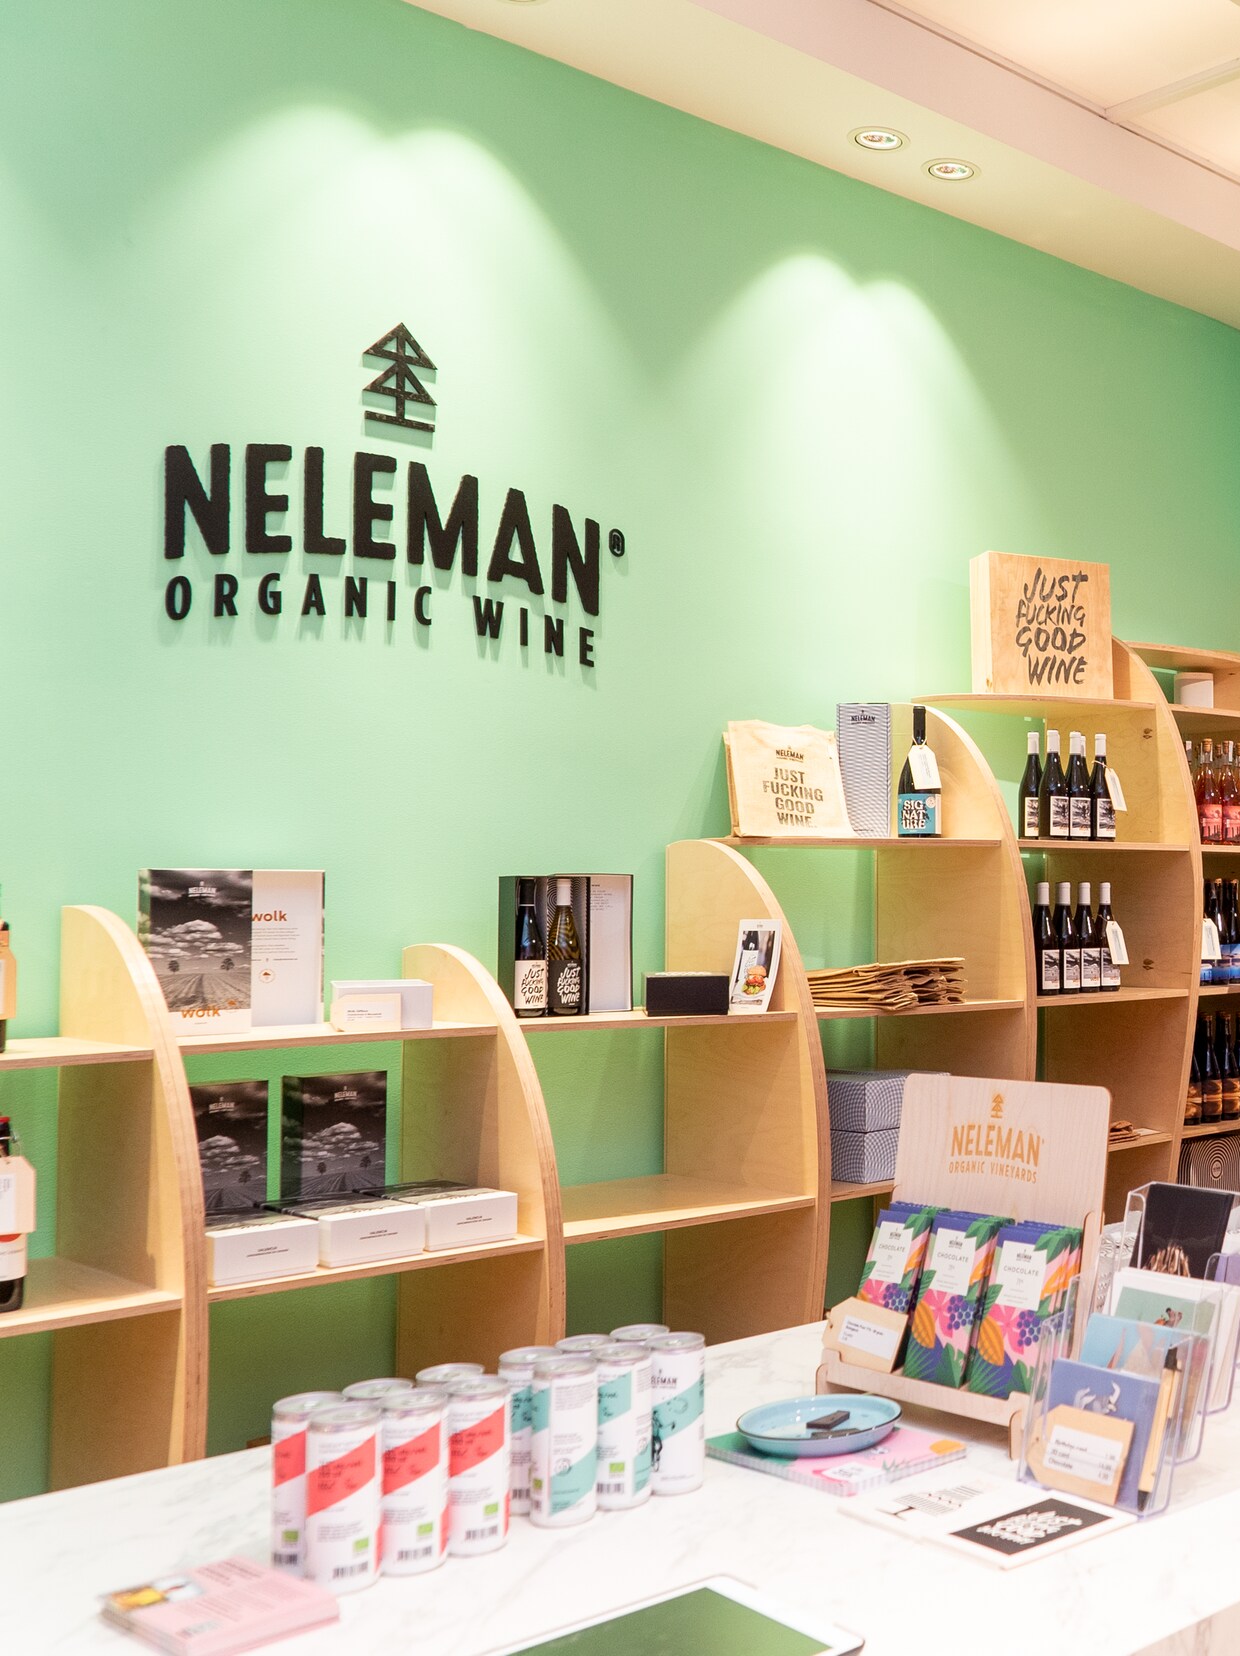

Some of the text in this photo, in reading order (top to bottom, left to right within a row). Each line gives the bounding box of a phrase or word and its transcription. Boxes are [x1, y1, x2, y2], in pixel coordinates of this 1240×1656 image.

[1023, 567, 1089, 604] JUST
[165, 572, 596, 668] ORGANIC WINE
[1016, 599, 1086, 628] FUCKING
[1016, 626, 1087, 658] GOOD
[1028, 654, 1088, 686] WINE
[775, 749, 804, 761] NELEMAN
[773, 767, 806, 785] JUST
[762, 780, 824, 802] FUCKING
[775, 797, 815, 814] GOOD
[904, 800, 924, 811] SIG
[901, 809, 926, 820] NAT
[524, 968, 545, 980] JUST
[560, 966, 581, 979] JUST
[556, 985, 580, 996] GOOD
[560, 992, 580, 1004] WINE
[951, 1124, 1041, 1168] NELEMAN
[949, 1161, 1038, 1184] ORGANIC VINEYARDS
[878, 1244, 906, 1252] CHOCOLATE
[936, 1252, 969, 1263] CHOCOLATE
[1003, 1265, 1040, 1277] CHOCOLATE
